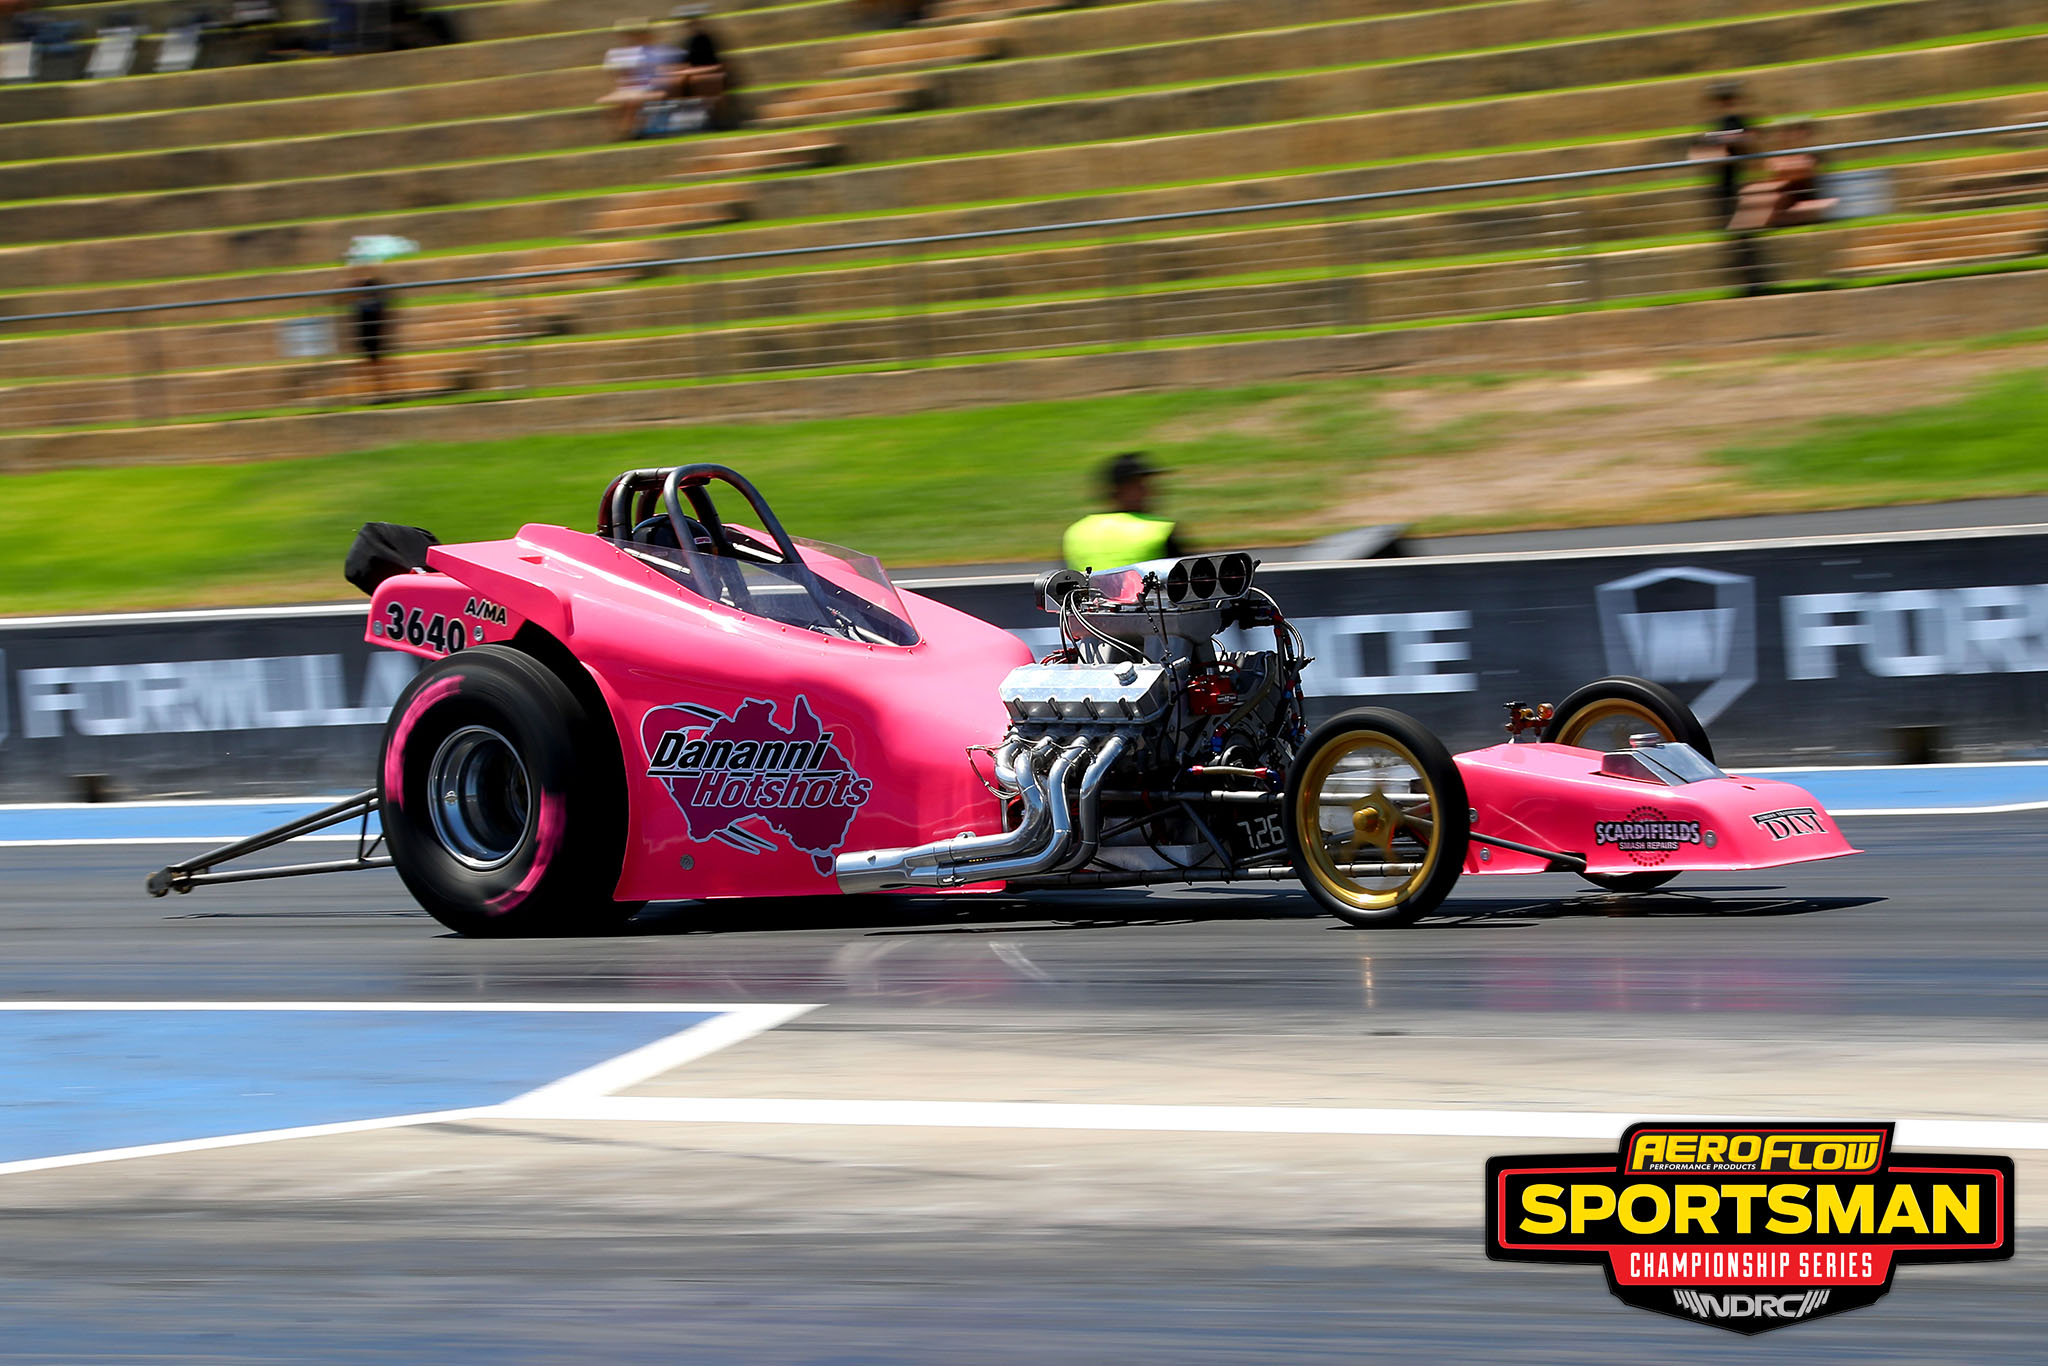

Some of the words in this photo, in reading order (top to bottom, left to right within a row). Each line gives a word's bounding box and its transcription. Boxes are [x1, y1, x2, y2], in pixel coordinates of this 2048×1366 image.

[385, 601, 467, 654] 3640
[463, 596, 508, 626] A/MA
[649, 731, 834, 771] Dananni
[691, 770, 874, 808] Hotshots
[1595, 822, 1701, 845] SCARDIFIELDS
[1619, 841, 1646, 851] SMASH
[1646, 841, 1679, 850] REPAIRS
